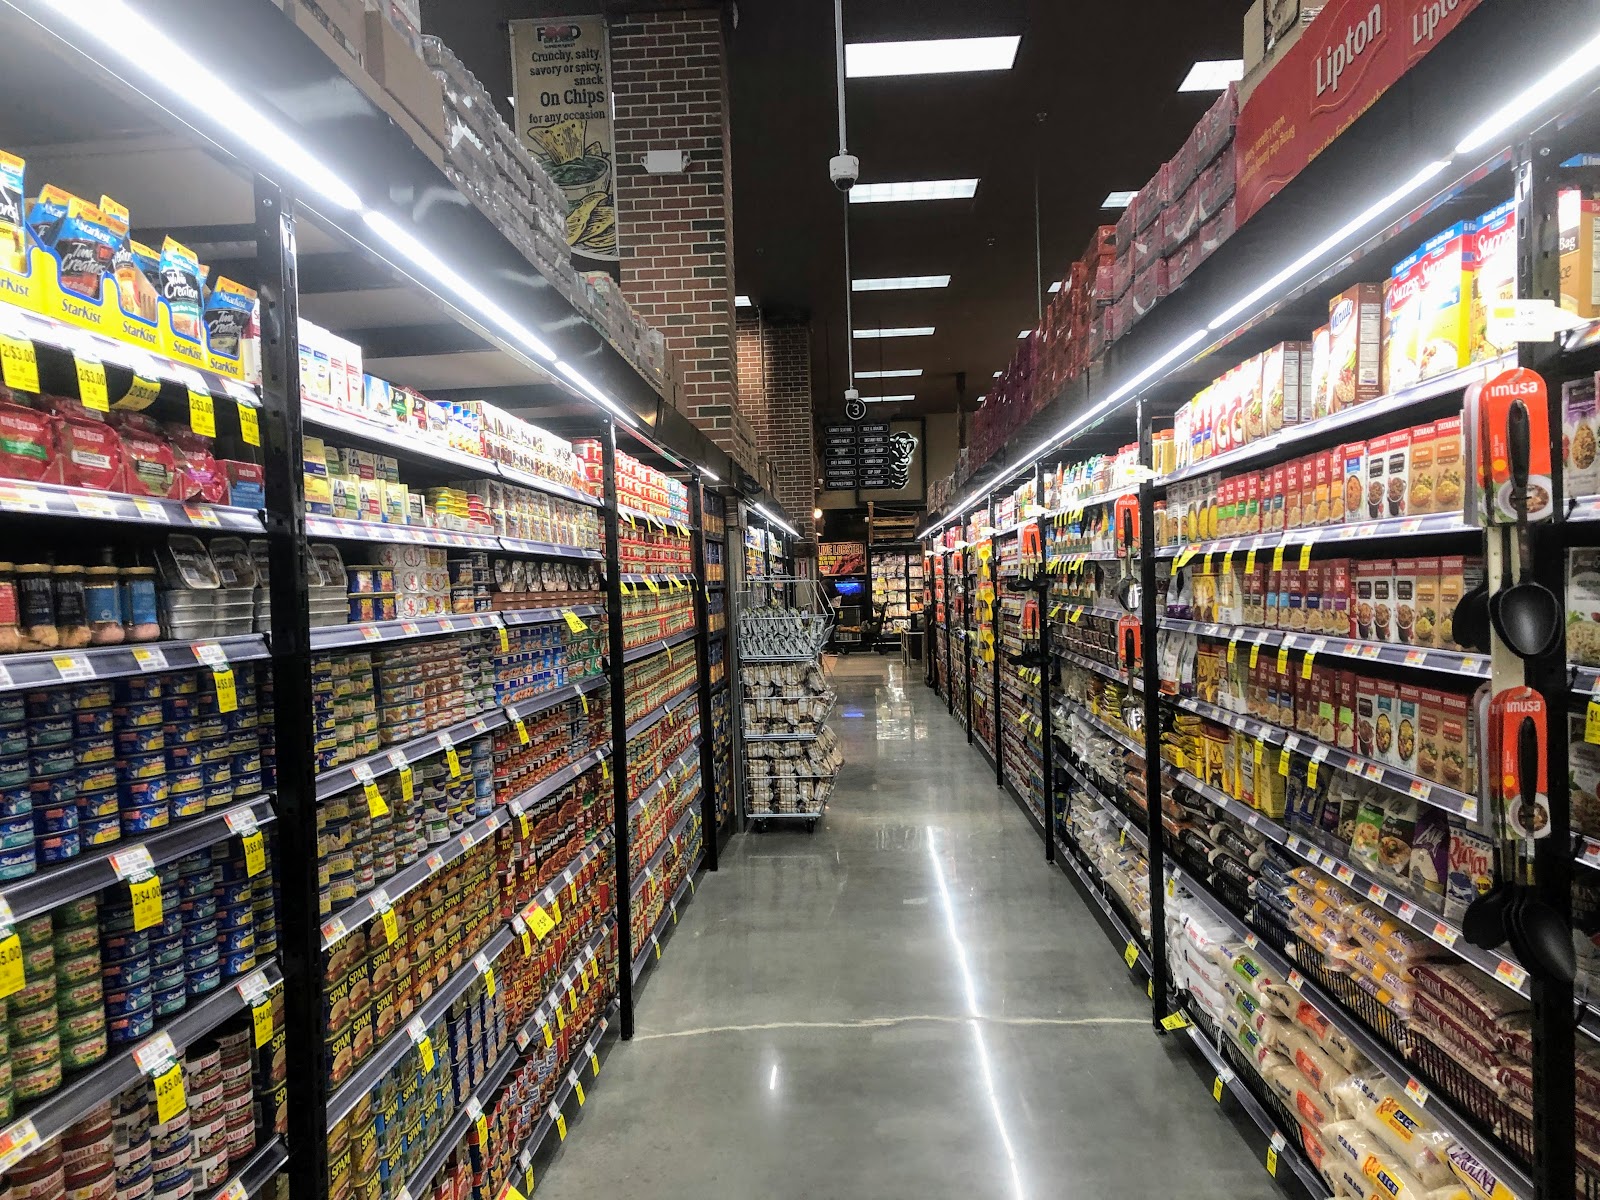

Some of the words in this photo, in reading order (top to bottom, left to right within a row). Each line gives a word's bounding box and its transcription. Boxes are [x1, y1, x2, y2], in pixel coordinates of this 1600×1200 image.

[1412, 0, 1459, 46] Lipto
[532, 50, 574, 62] Crunchy,
[1316, 3, 1382, 97] Lipton
[530, 65, 562, 76] savory
[574, 75, 604, 86] snack
[540, 92, 560, 107] On
[564, 89, 605, 108] Chips
[529, 114, 543, 123] for
[544, 113, 561, 124] any
[563, 110, 605, 121] occasion
[1559, 235, 1576, 251] Bag
[0, 277, 29, 297] rKist
[61, 298, 102, 324] StarKist
[122, 321, 157, 344] StarKist
[2, 343, 36, 364] 2/$3.00
[173, 341, 202, 360] StarKist
[79, 368, 106, 386] 2/$3.00
[210, 358, 239, 376] StarKist
[852, 404, 860, 415] 3
[833, 543, 864, 556] LOBSTER
[133, 886, 161, 906] 2/$4.00
[444, 894, 461, 908] SPAM
[431, 906, 444, 922] SPAM
[413, 919, 427, 936] SPAM
[393, 933, 408, 951] SPAM
[448, 932, 461, 949] SPAM
[372, 949, 390, 969] SPAM
[434, 945, 447, 962] SPAM
[349, 964, 368, 986] SPAM
[418, 959, 432, 977] SPAM
[329, 983, 347, 1005] SPAM
[397, 975, 412, 995] SPAM
[376, 992, 393, 1014] SPAM
[353, 1010, 371, 1034] SPAM
[332, 1031, 350, 1056] SPAM
[157, 1072, 183, 1097] 4/$5.00
[402, 1078, 418, 1102] SPAM
[384, 1100, 399, 1124] SPAM
[425, 1098, 438, 1122] SPAM
[361, 1122, 377, 1150] SPAM
[407, 1120, 422, 1145] SPAM
[331, 1151, 351, 1180] SPAM
[388, 1143, 403, 1171] SPAM
[366, 1169, 381, 1197] SPAM
[1377, 1170, 1399, 1197] RICE
